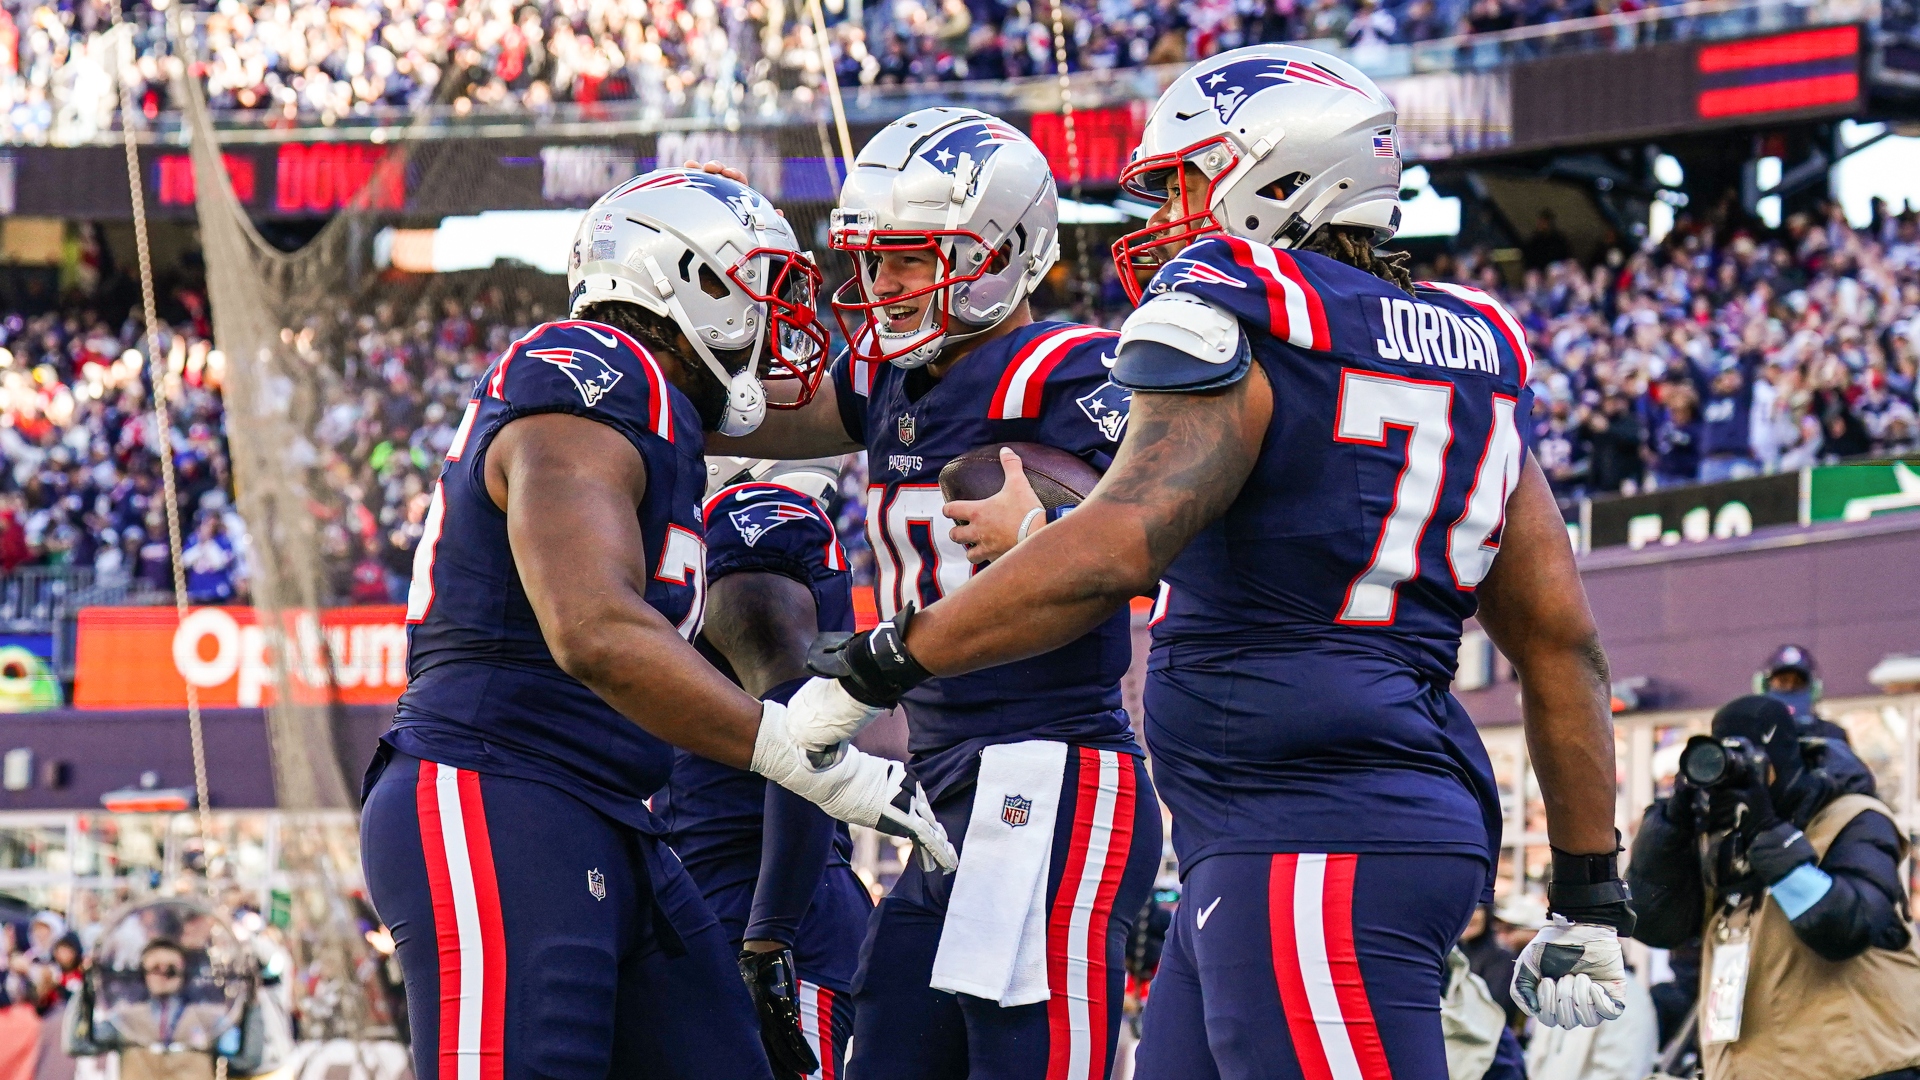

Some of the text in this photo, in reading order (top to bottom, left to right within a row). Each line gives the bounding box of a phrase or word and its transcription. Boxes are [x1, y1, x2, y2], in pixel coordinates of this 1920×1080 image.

[1376, 297, 1500, 376] JORDAN
[888, 454, 923, 471] PATRIOTS
[866, 483, 979, 622] 10
[1003, 807, 1026, 824] NFL
